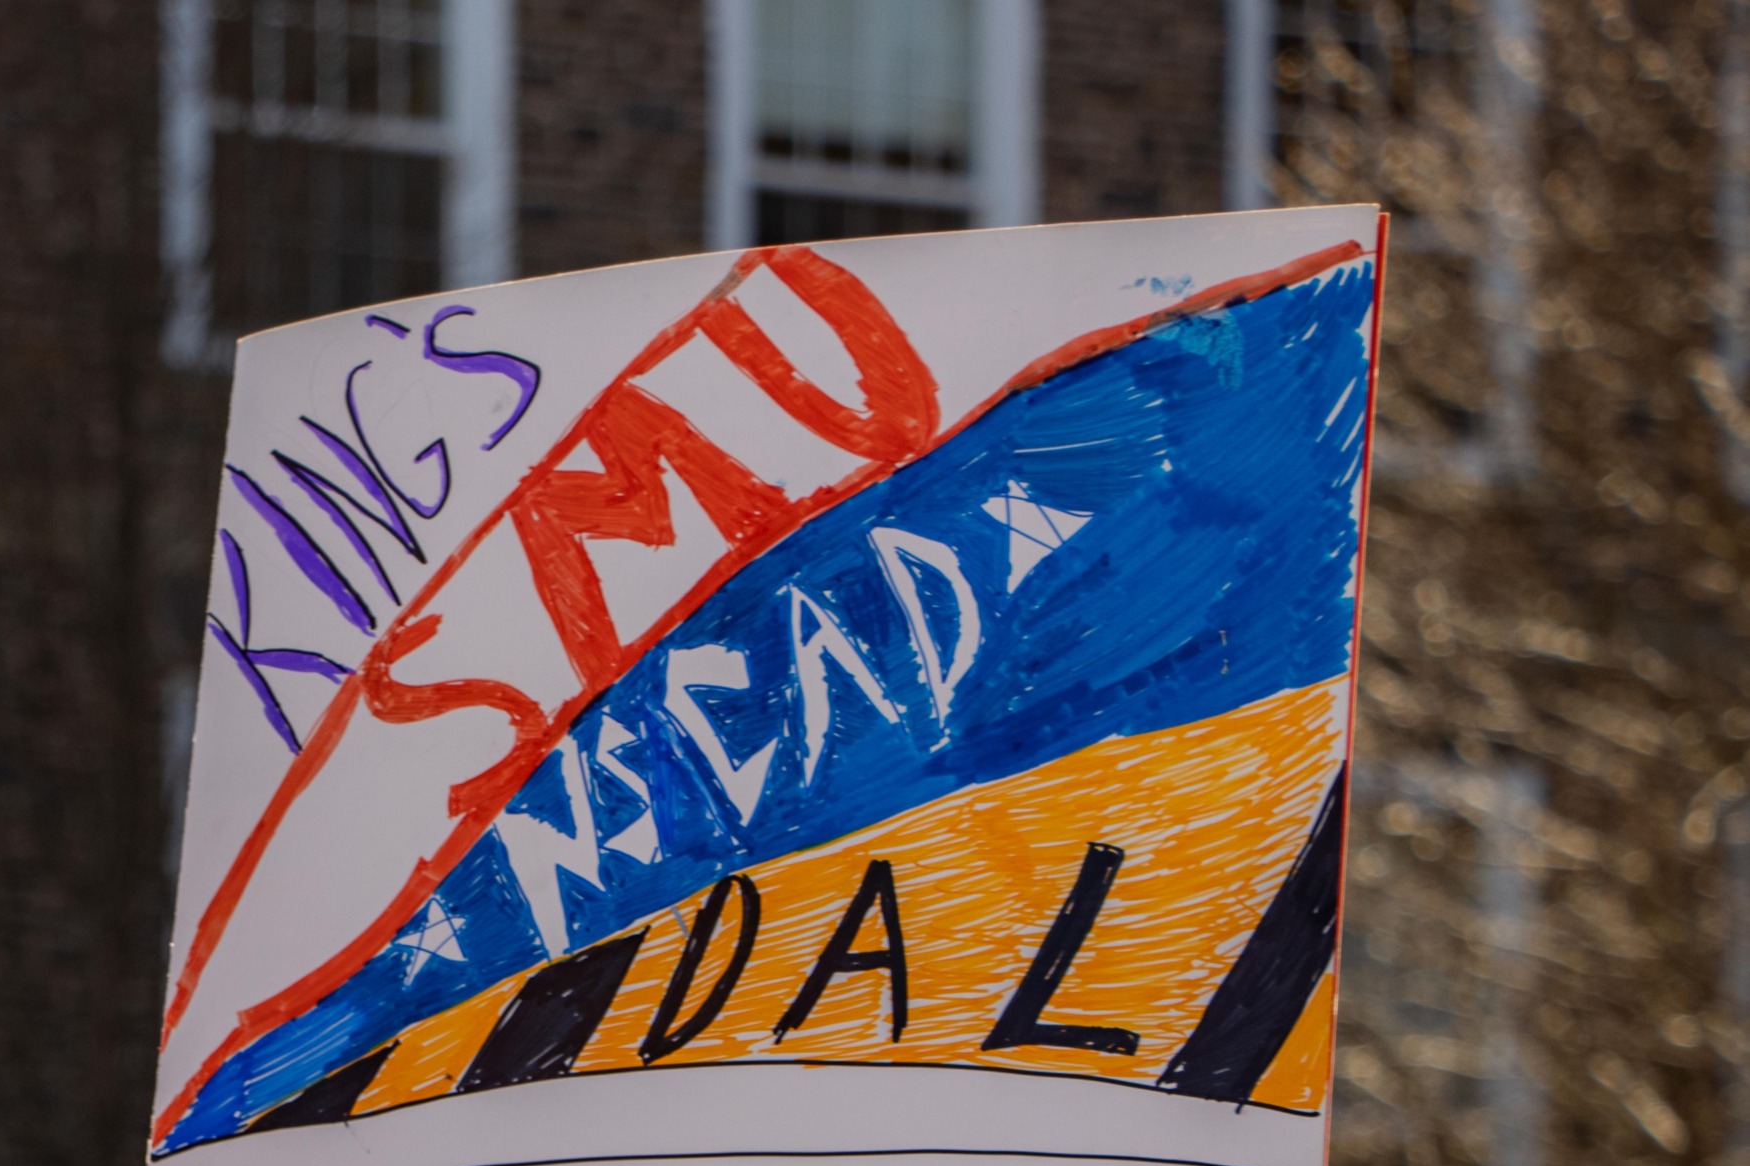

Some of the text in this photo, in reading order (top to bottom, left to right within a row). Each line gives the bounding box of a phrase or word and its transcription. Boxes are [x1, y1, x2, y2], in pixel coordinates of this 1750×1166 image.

[206, 305, 541, 756] KING'S
[356, 243, 942, 820] SMU
[490, 524, 982, 961] NSCAD
[639, 841, 1140, 1066] DAL
